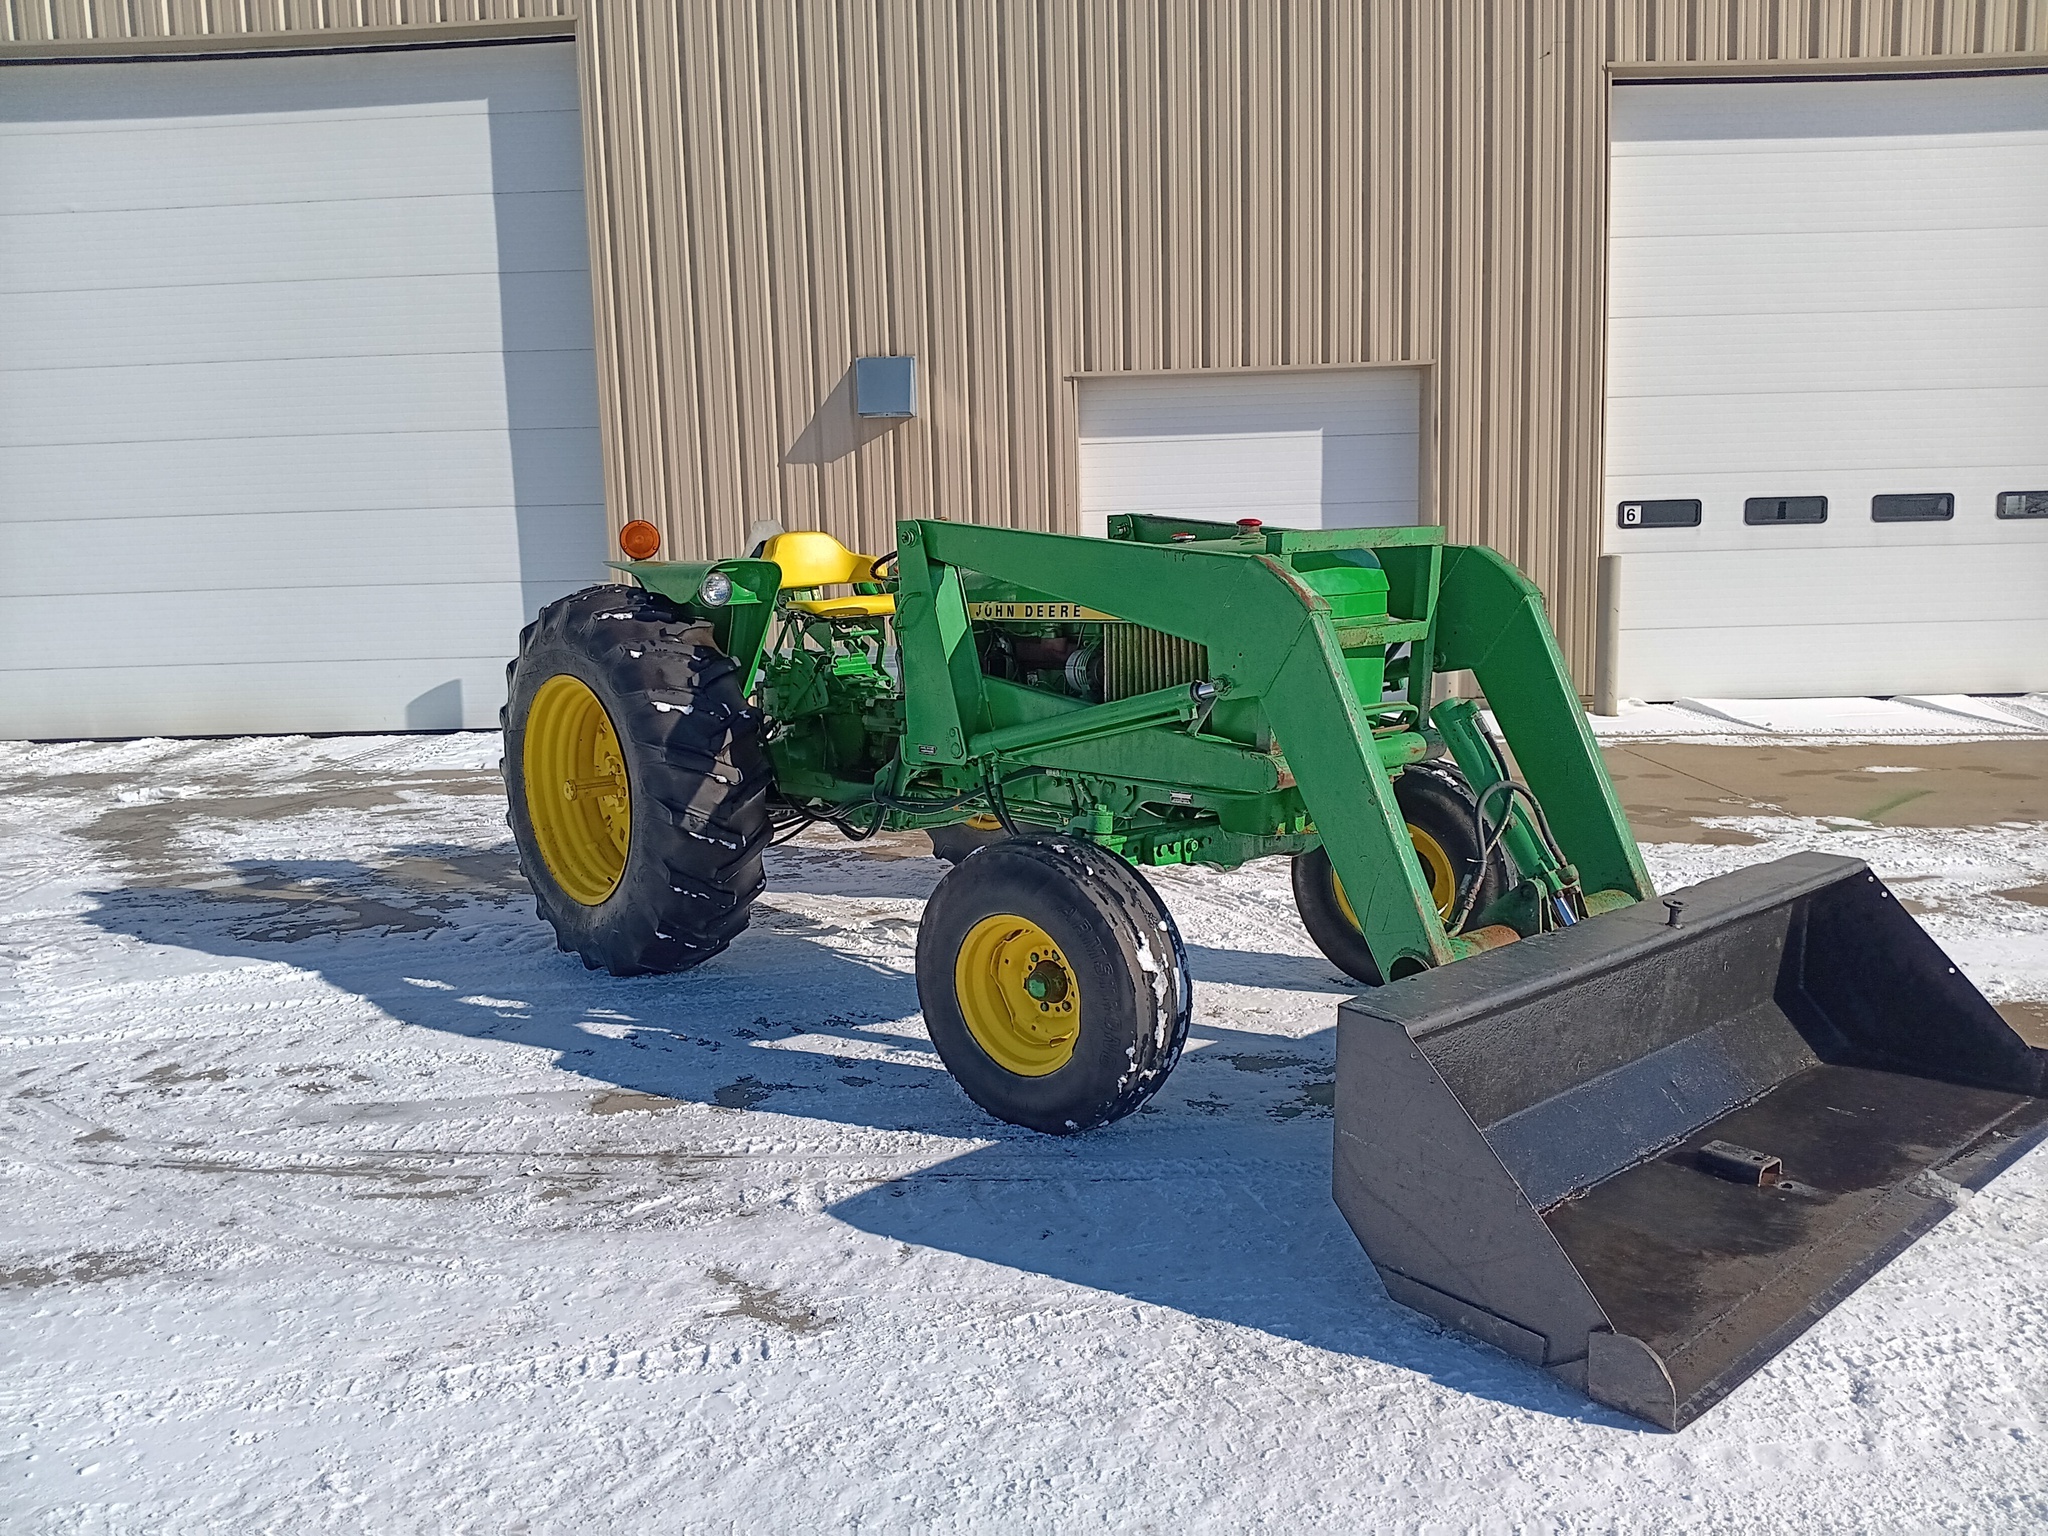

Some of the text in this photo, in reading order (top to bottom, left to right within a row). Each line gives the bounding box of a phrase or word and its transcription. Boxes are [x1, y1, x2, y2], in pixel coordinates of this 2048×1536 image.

[1626, 508, 1636, 522] 6
[975, 604, 1081, 618] JOHN DEERE
[1058, 905, 1122, 1070] ARMSTRONG
